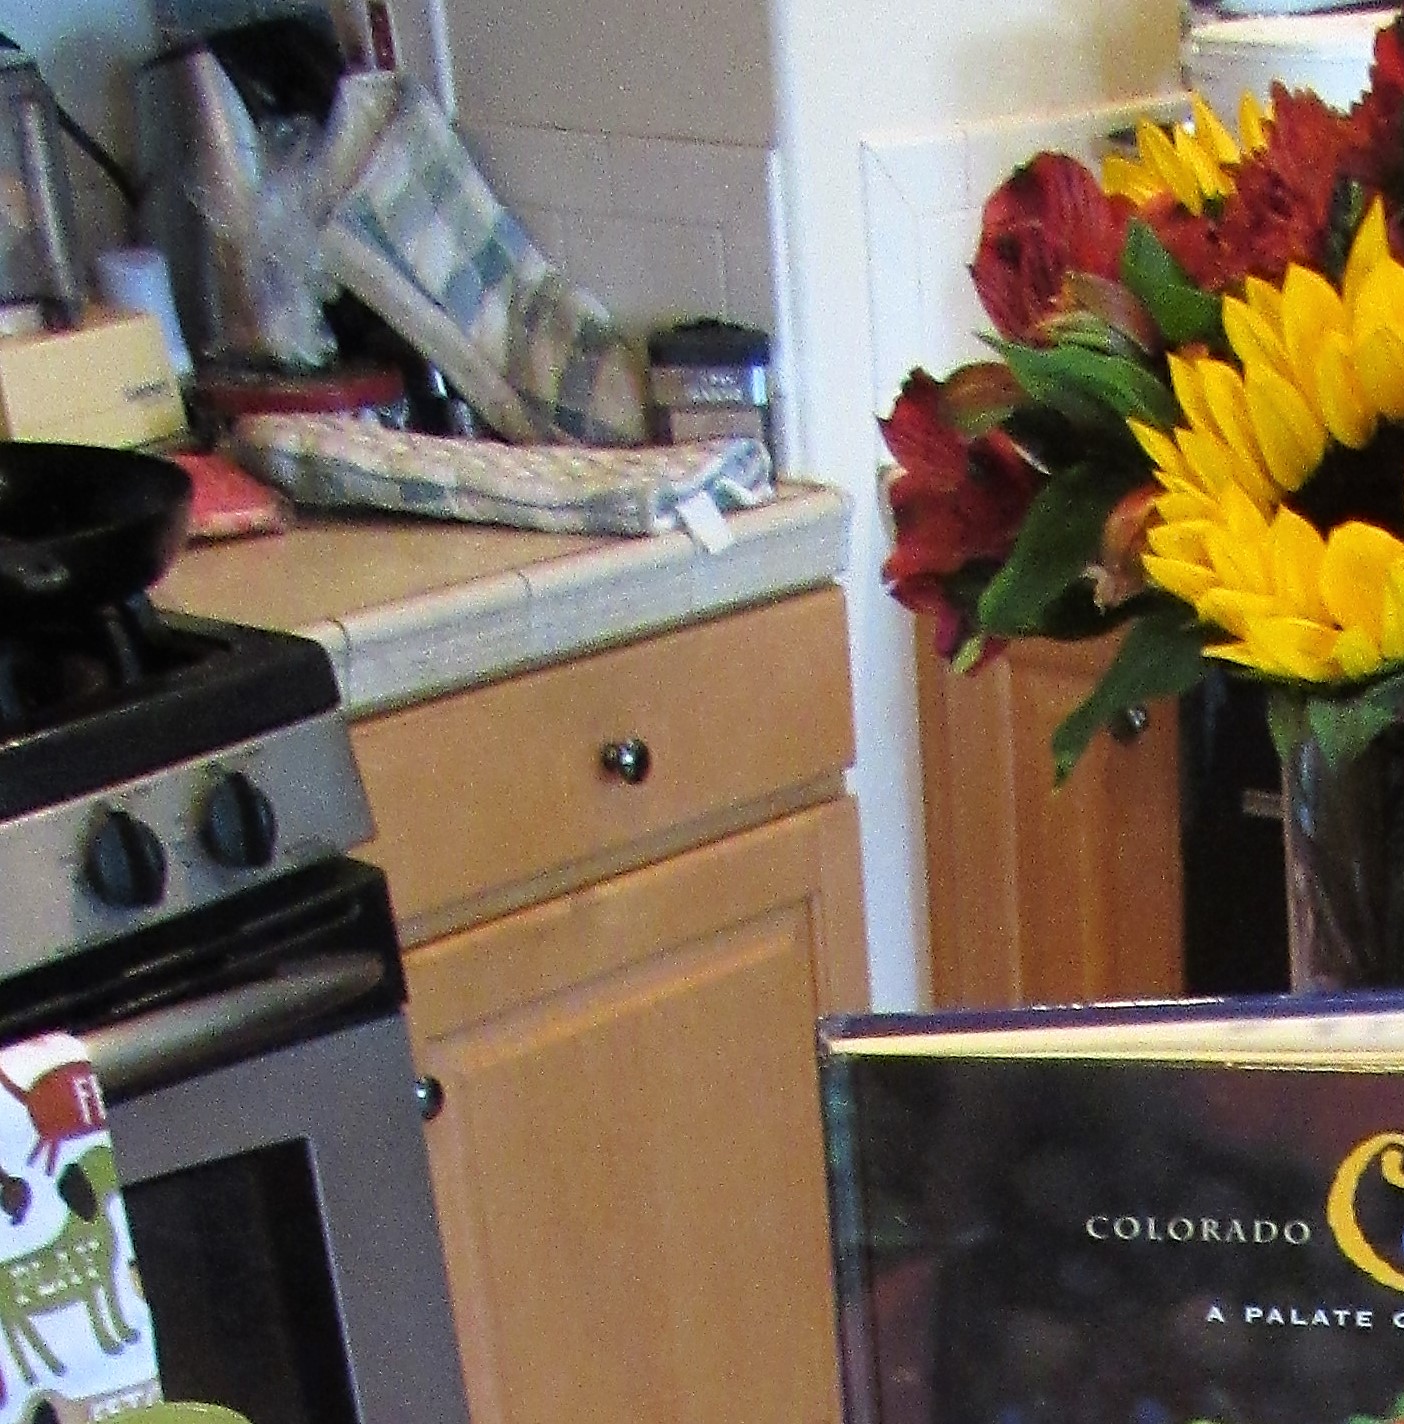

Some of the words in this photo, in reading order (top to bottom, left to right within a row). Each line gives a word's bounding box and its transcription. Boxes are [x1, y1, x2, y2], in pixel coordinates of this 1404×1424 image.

[1085, 1215, 1312, 1246] COLORADO
[1205, 1304, 1225, 1324] A
[1244, 1305, 1374, 1329] PALATE
